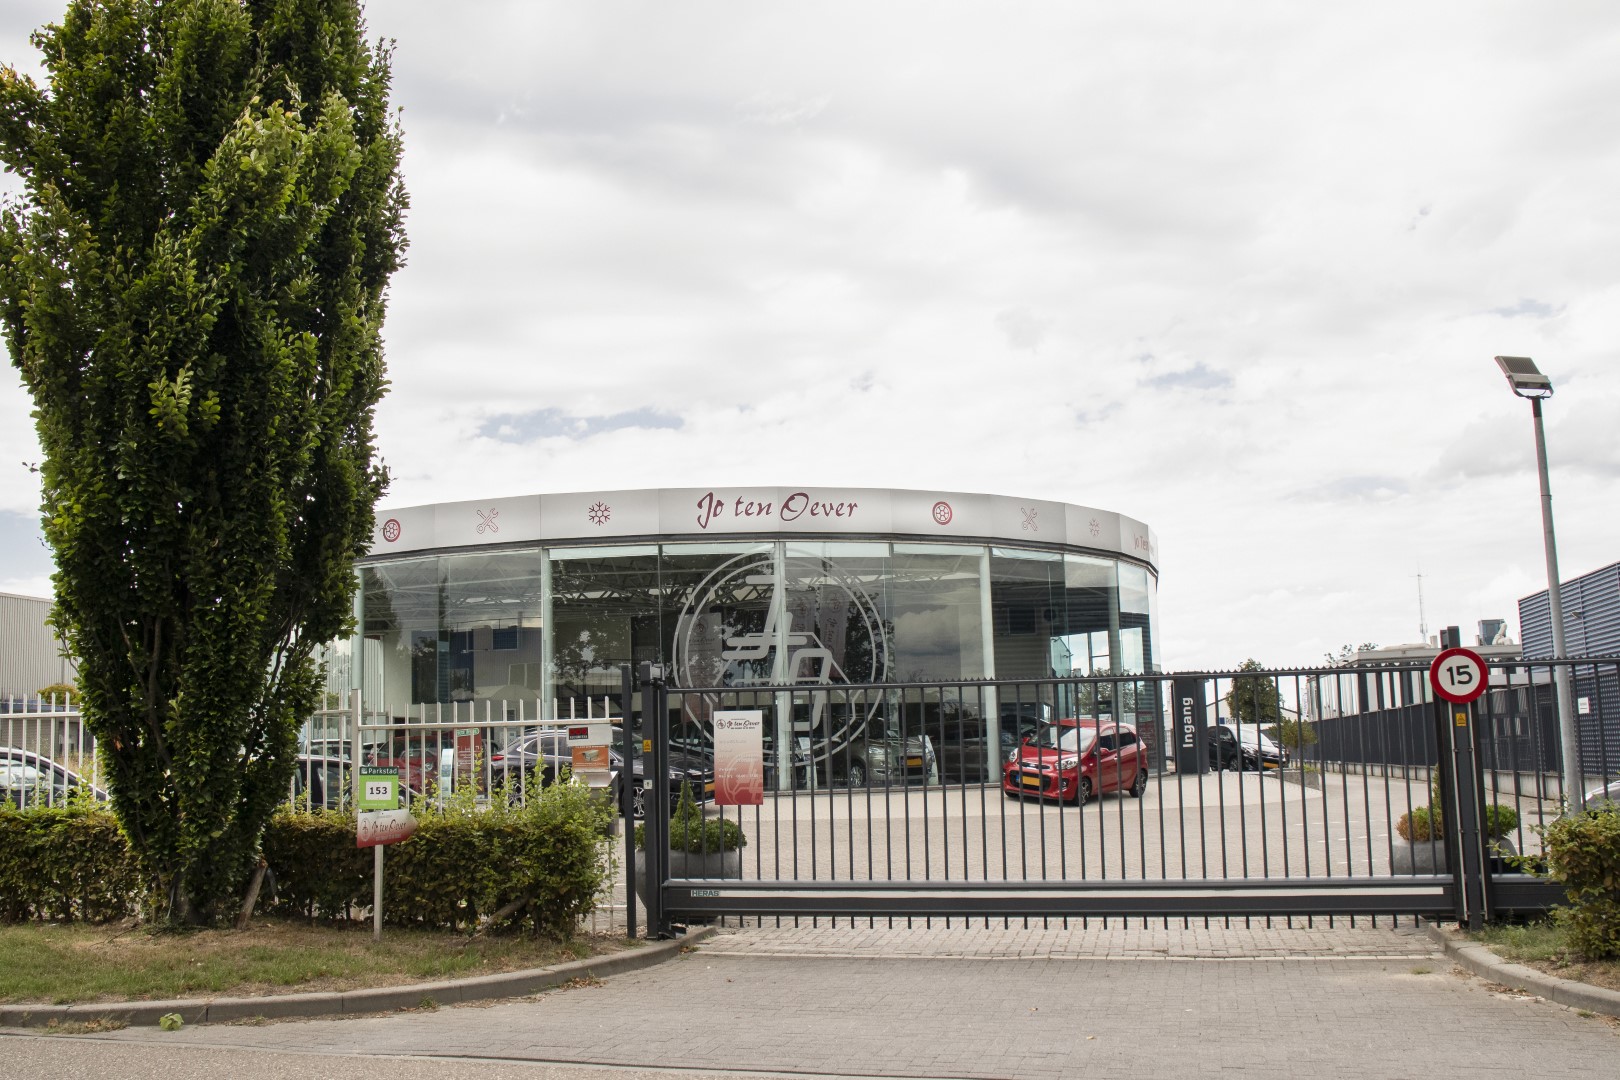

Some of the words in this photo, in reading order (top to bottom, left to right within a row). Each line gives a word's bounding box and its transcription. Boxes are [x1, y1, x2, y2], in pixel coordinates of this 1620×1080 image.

[696, 491, 725, 530] Jo
[734, 495, 772, 517] ten
[780, 492, 859, 522] Oever
[1446, 664, 1473, 686] 15
[1182, 697, 1195, 748] Ingang
[368, 767, 398, 775] Parkstad
[369, 786, 388, 795] 153
